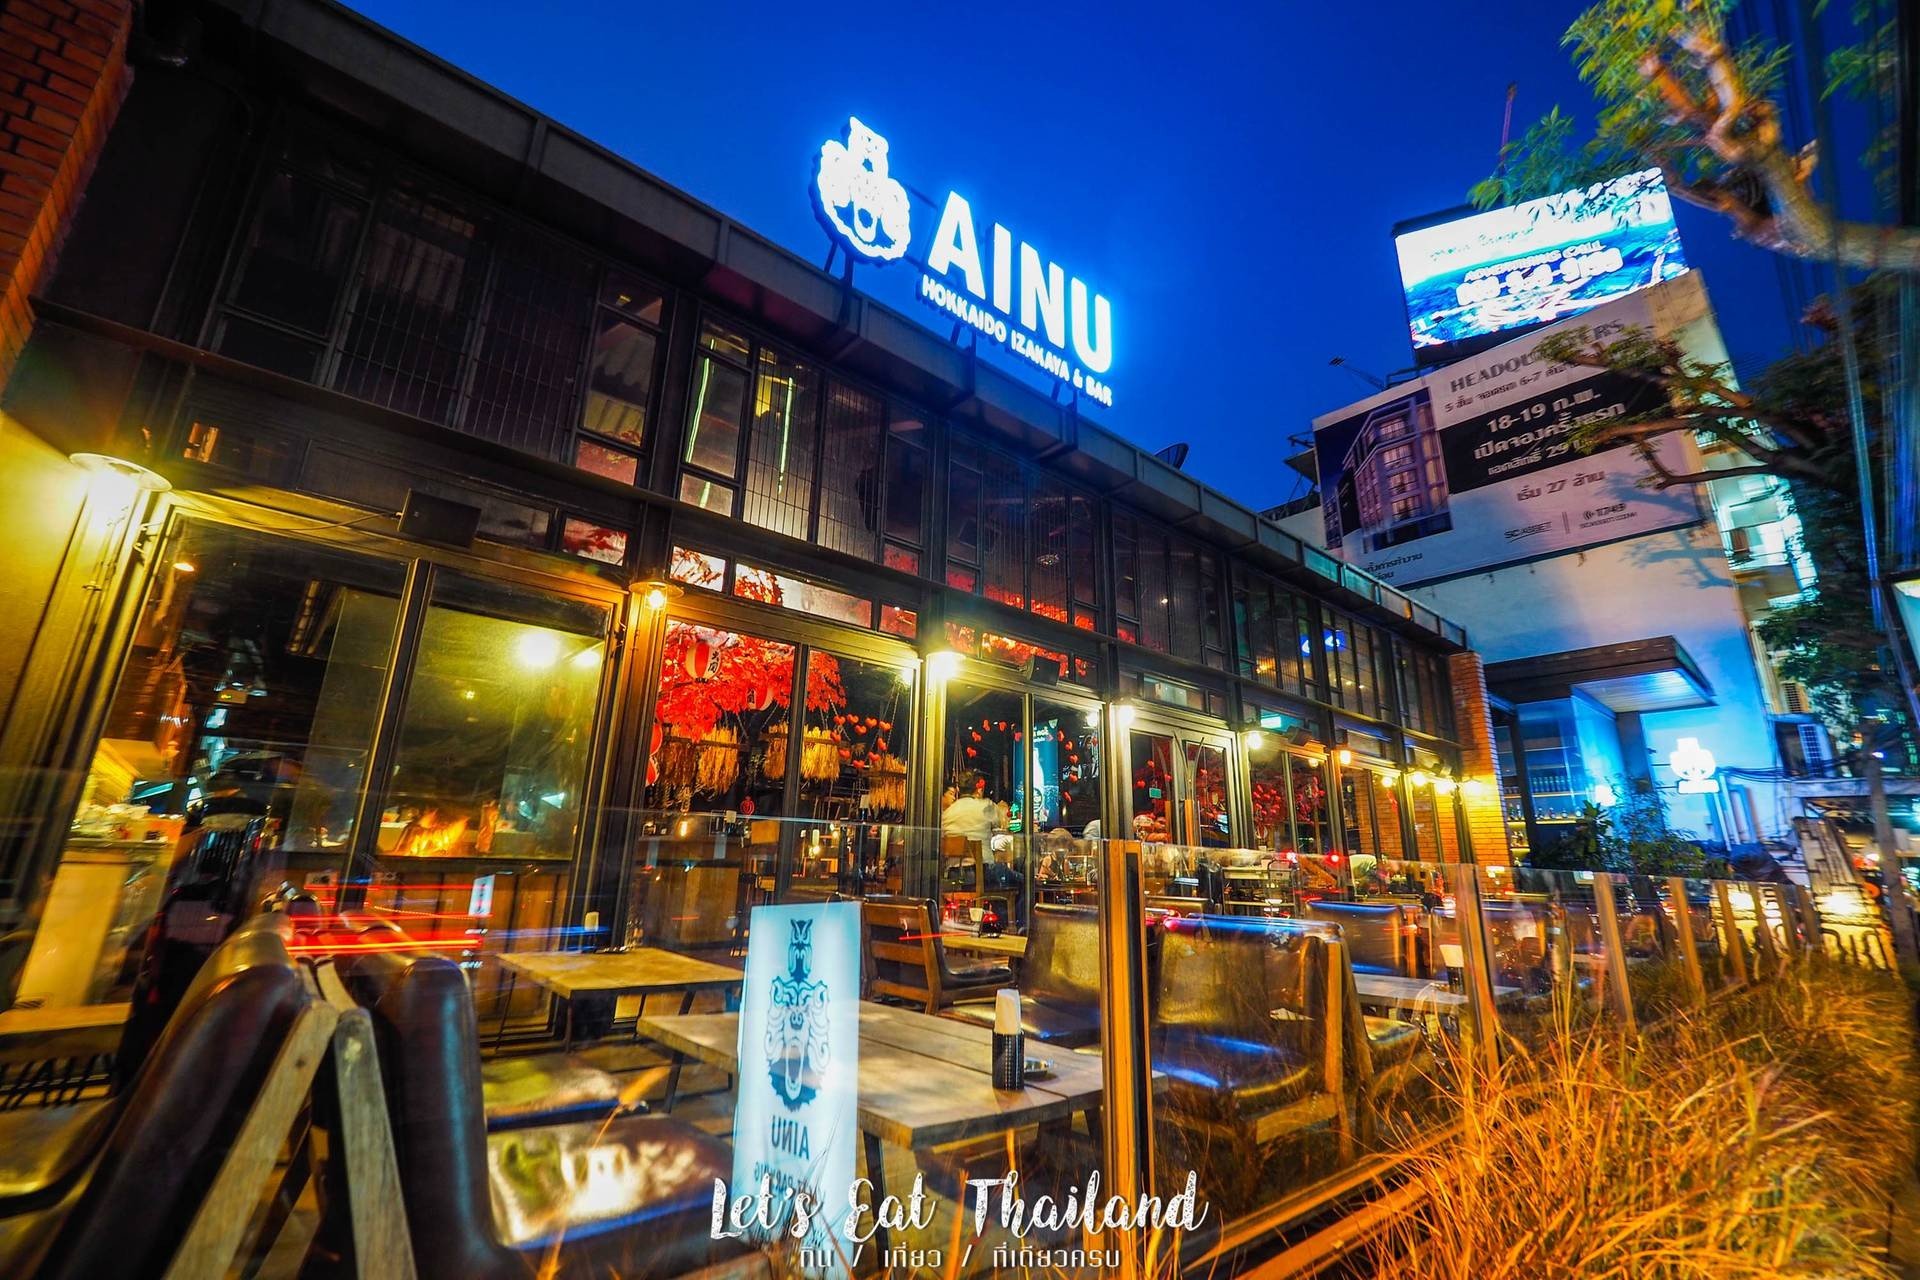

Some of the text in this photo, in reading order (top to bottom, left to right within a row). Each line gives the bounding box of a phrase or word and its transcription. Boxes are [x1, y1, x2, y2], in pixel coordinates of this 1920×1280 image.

[927, 190, 1112, 373] AINU
[922, 274, 1112, 407] HOKKAIDO IZAKAYA & BAR
[1487, 402, 1547, 433] 18-19
[1545, 442, 1568, 459] 29
[1547, 479, 1568, 494] 27
